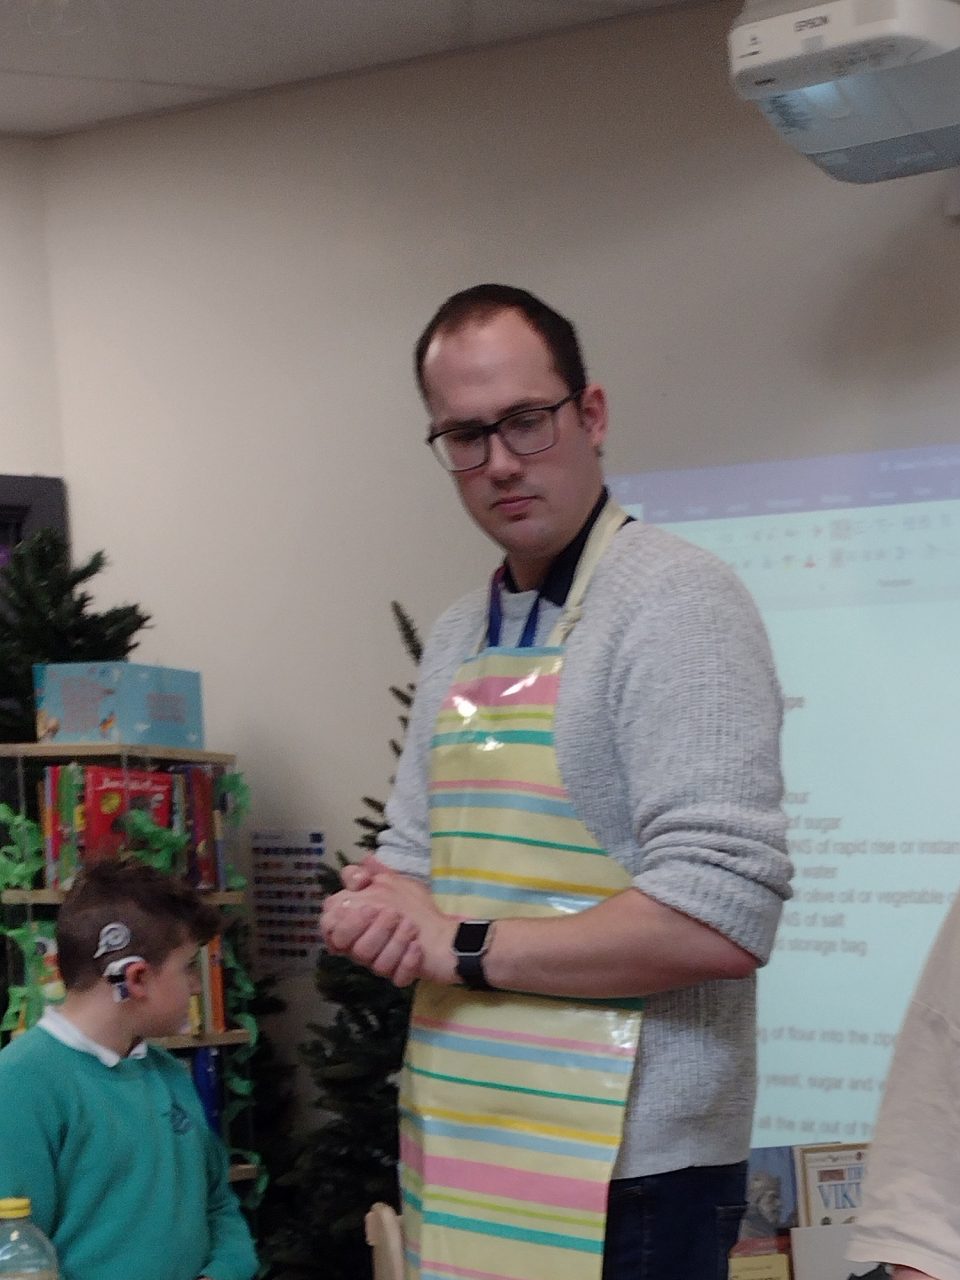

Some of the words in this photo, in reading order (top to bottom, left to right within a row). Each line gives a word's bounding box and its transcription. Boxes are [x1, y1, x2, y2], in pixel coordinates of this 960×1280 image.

[795, 16, 829, 32] EPSON
[817, 839, 830, 854] of
[833, 840, 867, 857] rapid
[871, 841, 896, 854] rise
[876, 888, 944, 908] vegetable
